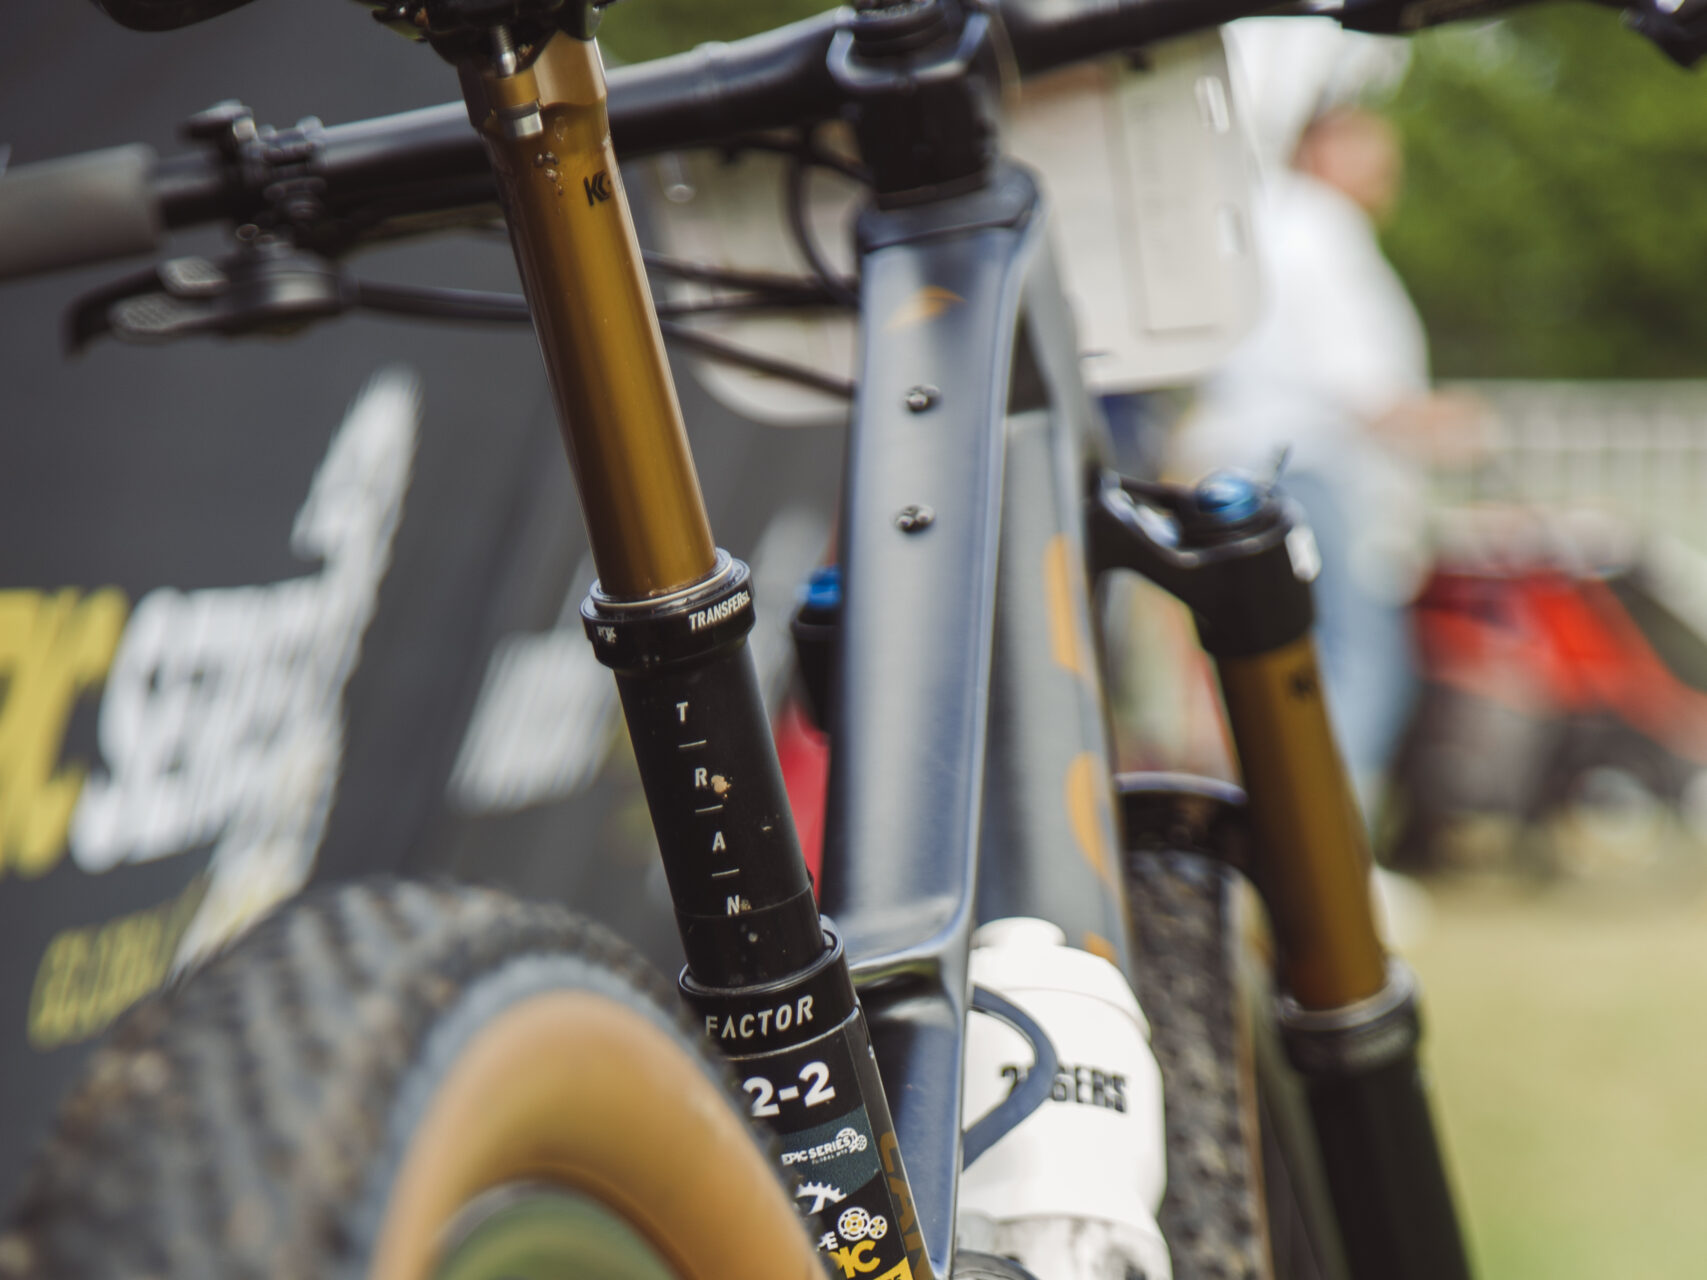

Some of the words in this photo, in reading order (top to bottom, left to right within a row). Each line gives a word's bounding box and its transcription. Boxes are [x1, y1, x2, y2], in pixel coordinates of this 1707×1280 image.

[688, 591, 742, 633] TRANSFER
[706, 994, 814, 1037] FACTOR
[781, 1149, 809, 1167] EPIC
[808, 1134, 852, 1160] SERIES
